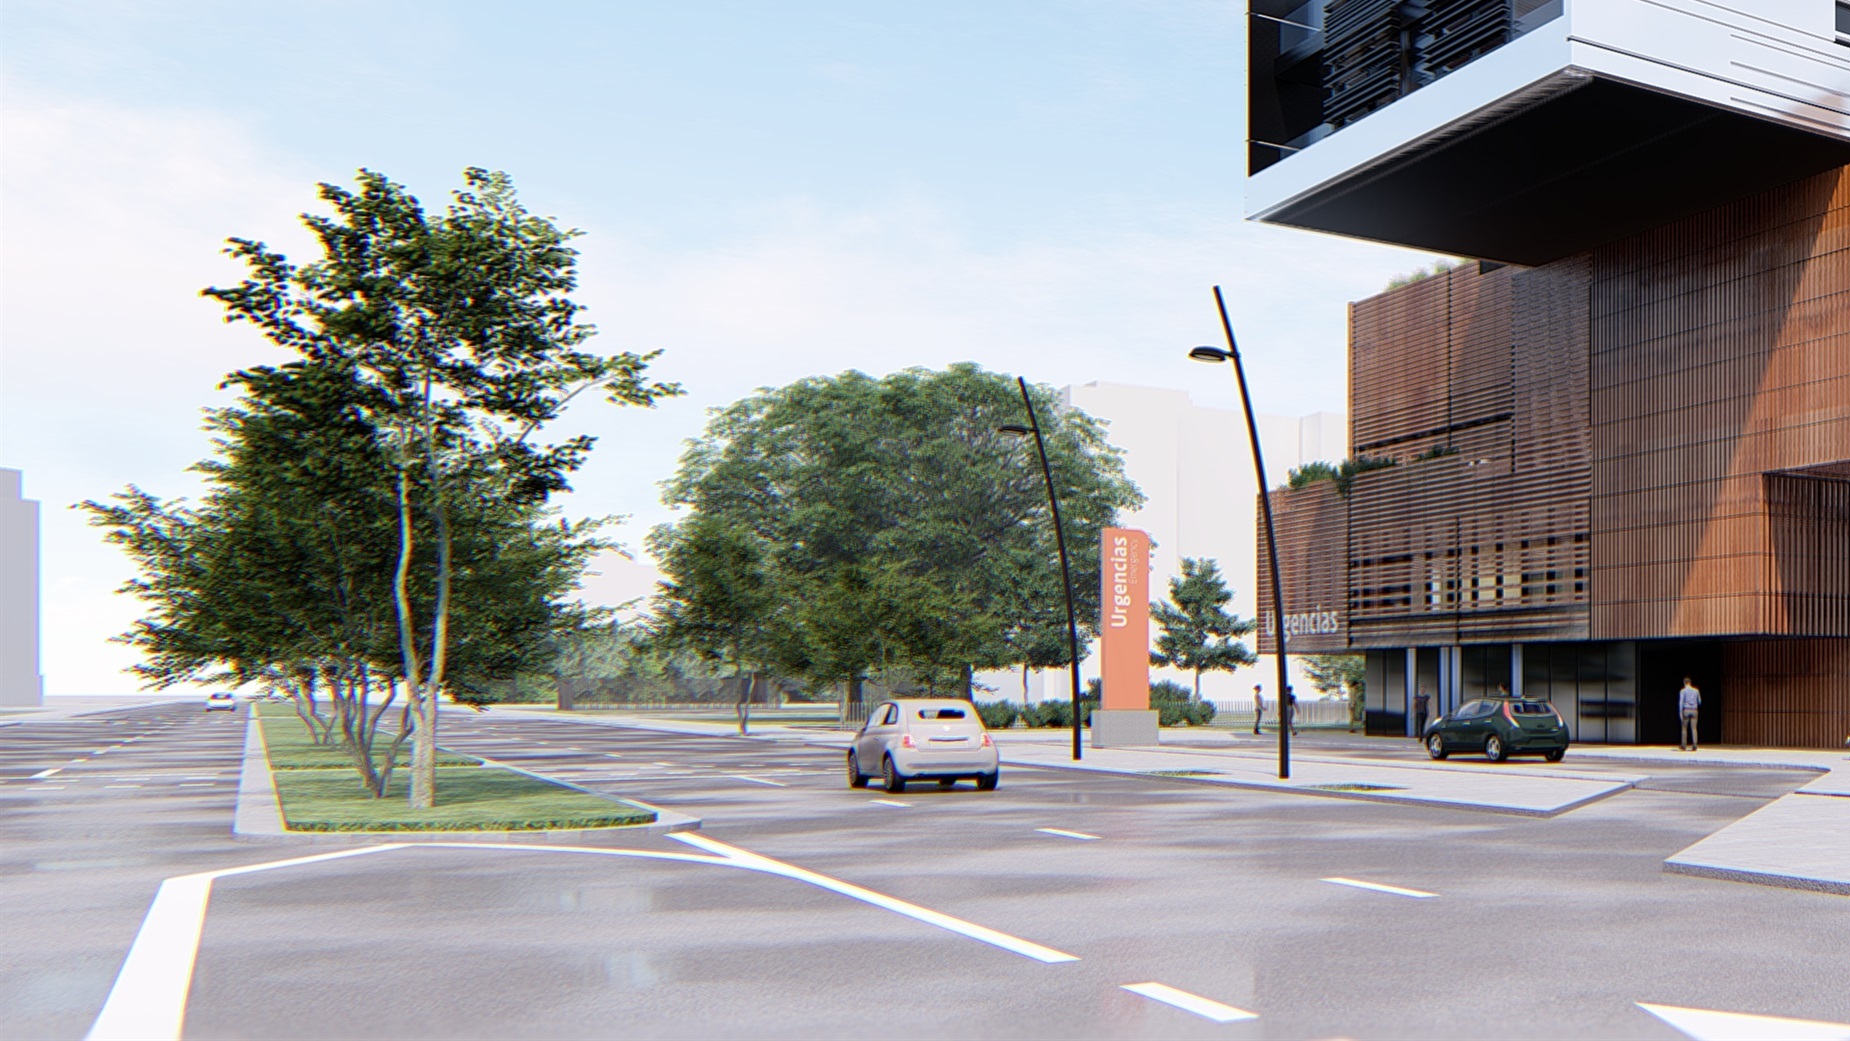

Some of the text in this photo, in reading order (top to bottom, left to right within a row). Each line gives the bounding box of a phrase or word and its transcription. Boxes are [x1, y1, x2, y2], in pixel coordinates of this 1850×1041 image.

[1110, 536, 1131, 628] Urgencias
[1128, 538, 1140, 585] Emergency
[1266, 604, 1339, 643] Ugencias
